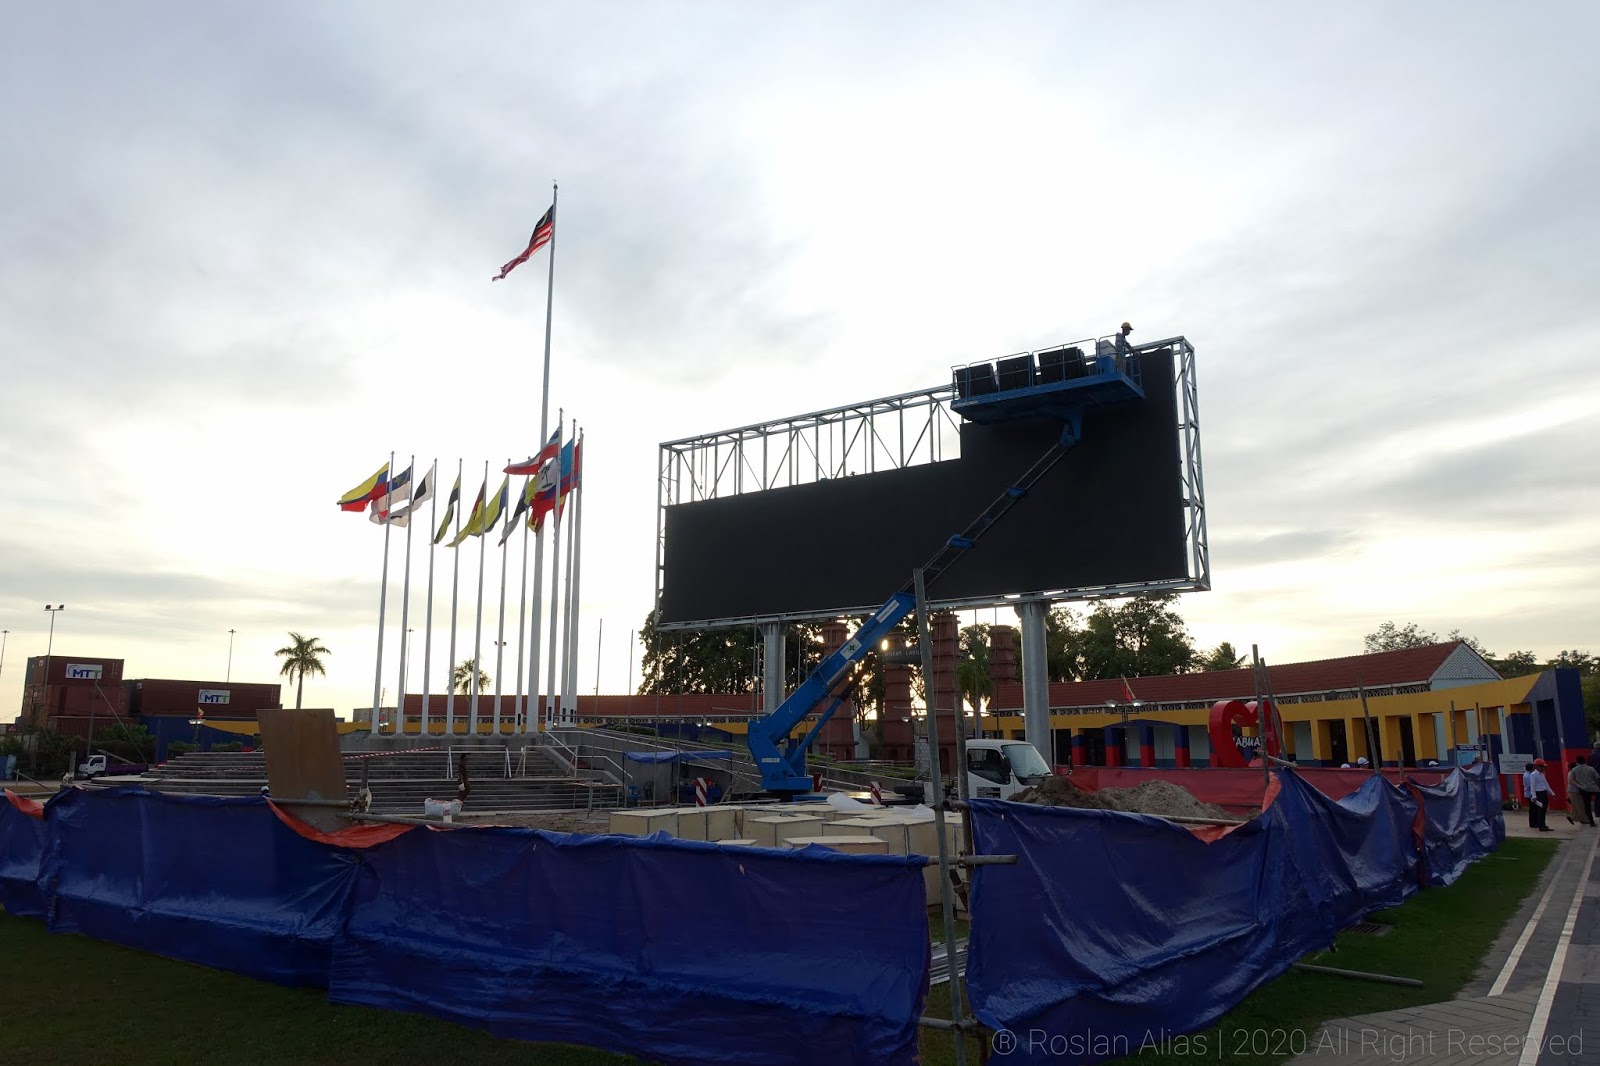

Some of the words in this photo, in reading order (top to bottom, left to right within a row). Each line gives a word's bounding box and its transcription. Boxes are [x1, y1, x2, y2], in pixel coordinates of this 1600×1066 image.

[72, 669, 101, 678] MTT
[204, 694, 229, 703] MTT
[1232, 736, 1261, 748] ABUA
